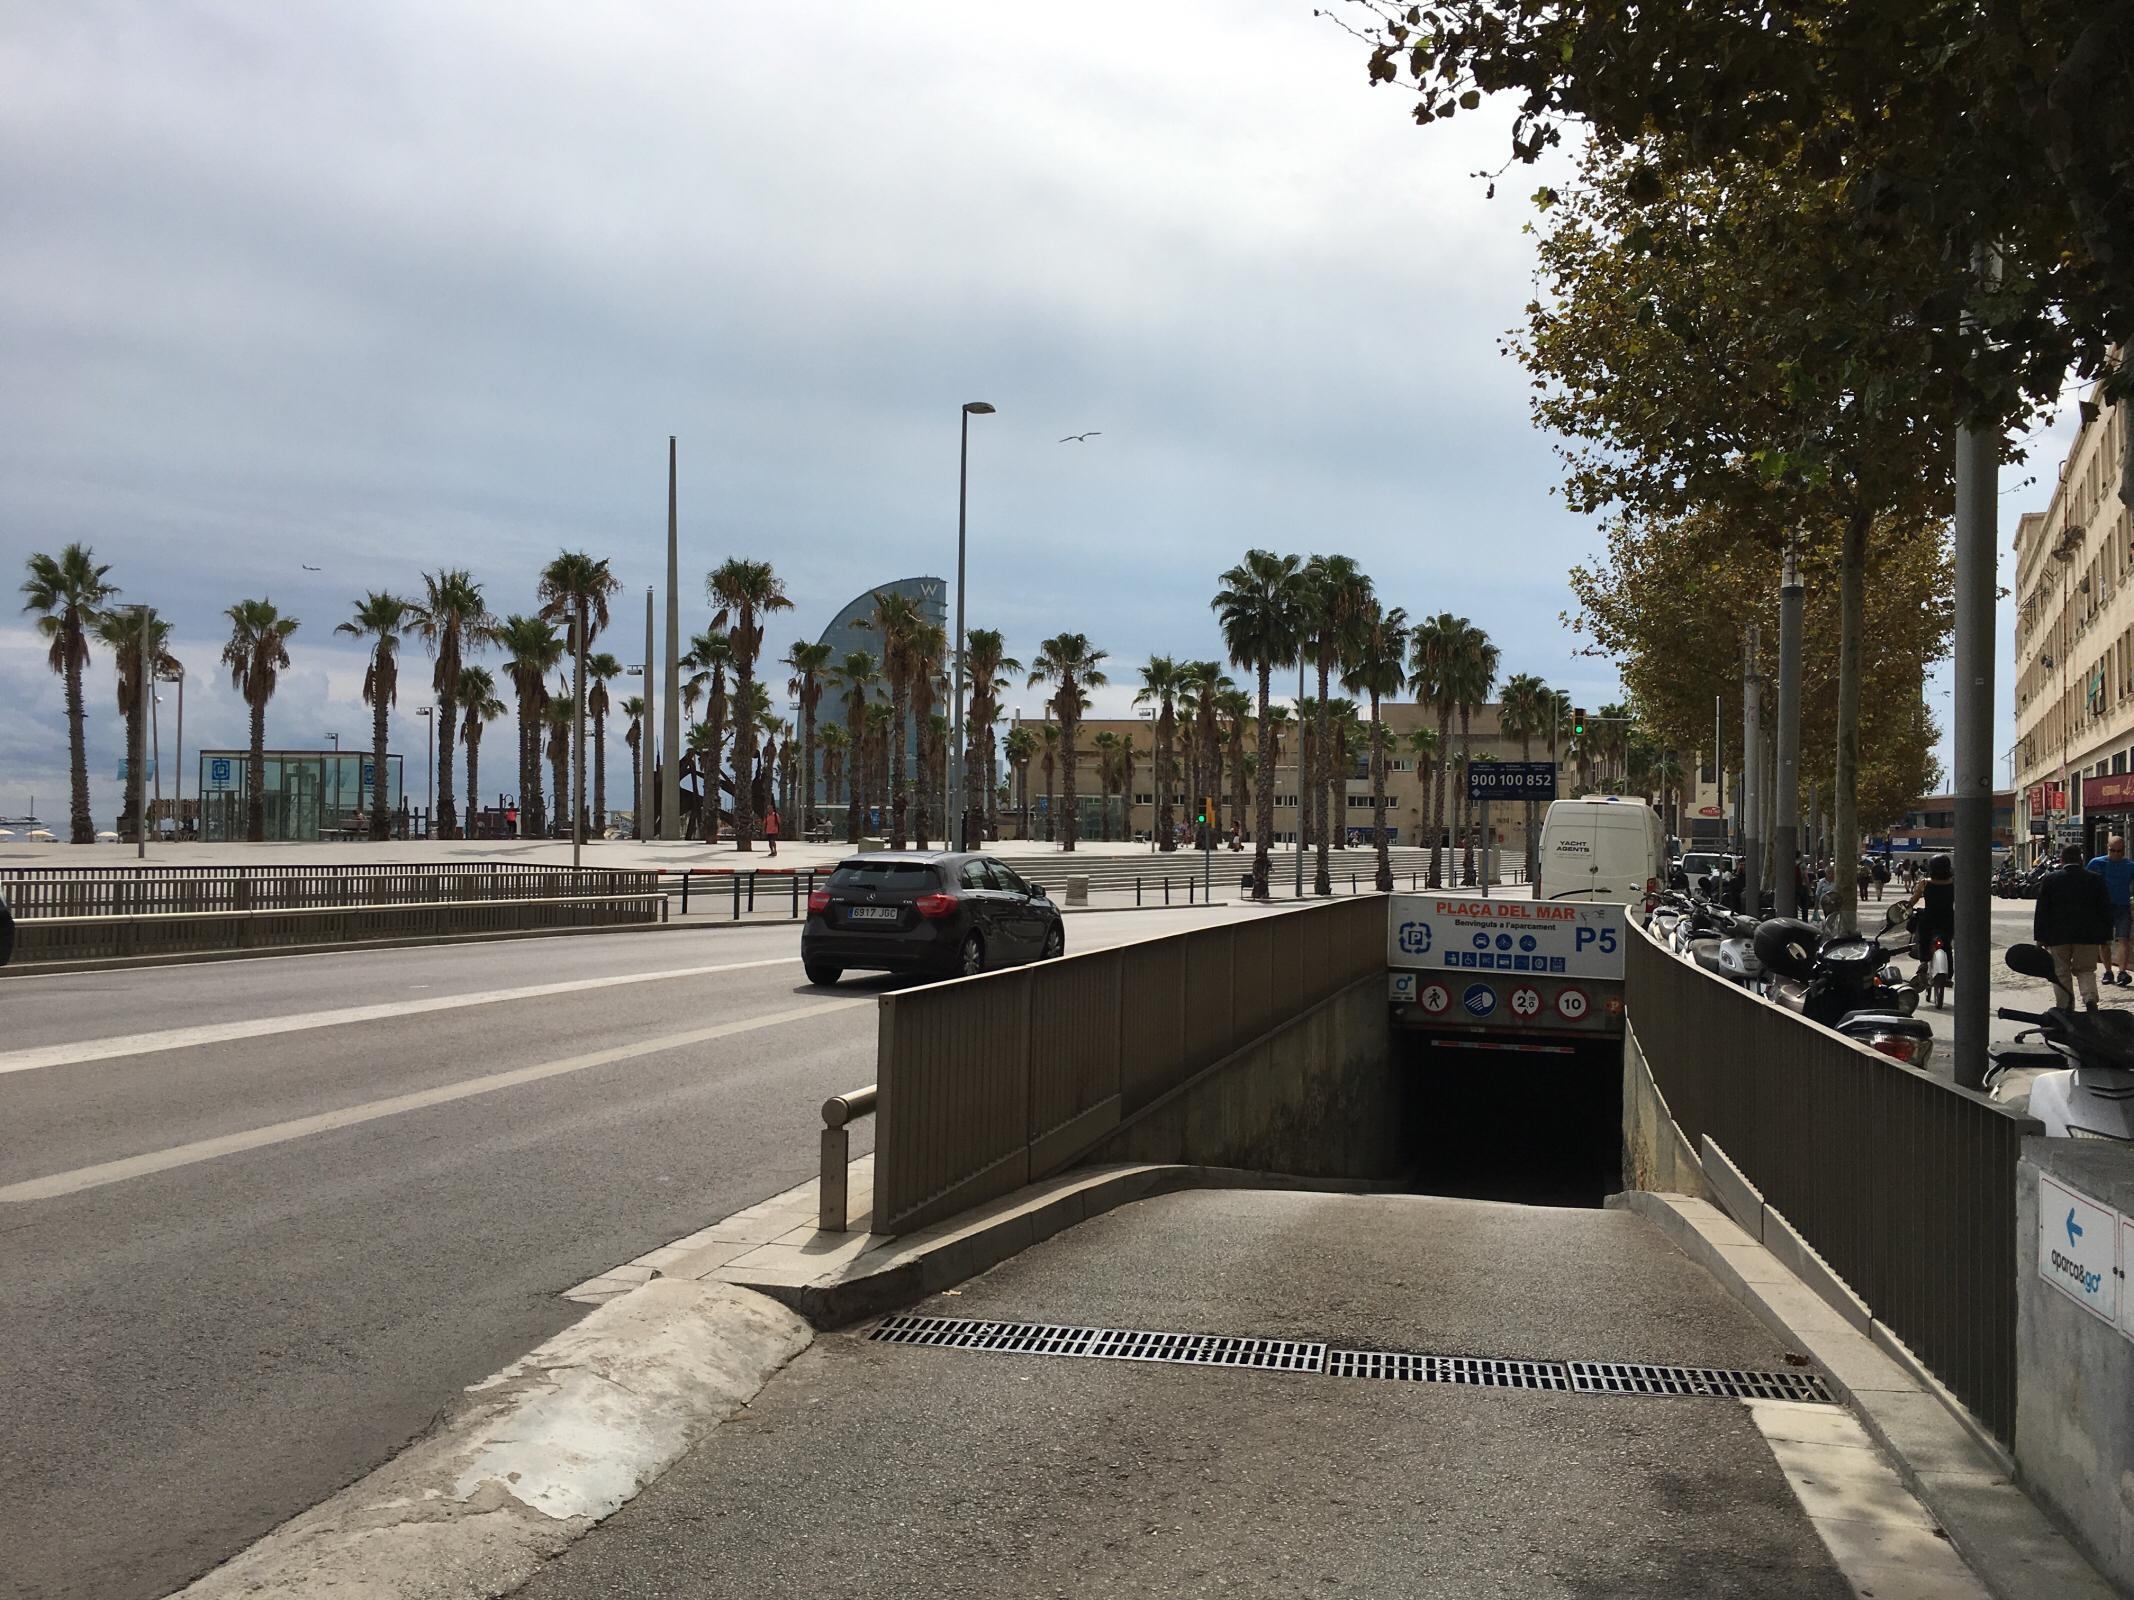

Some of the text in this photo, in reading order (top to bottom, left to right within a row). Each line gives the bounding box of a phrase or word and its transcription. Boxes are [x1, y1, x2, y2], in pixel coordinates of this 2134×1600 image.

[920, 583, 938, 597] W
[1471, 774, 1552, 786] 900 100 852
[854, 908, 896, 918] 6917 JGC
[1436, 902, 1492, 917] PLAÇA
[1497, 904, 1531, 917] DEL
[1536, 906, 1576, 919] MAR
[1454, 918, 1498, 929] Benvinguts
[1505, 922, 1556, 931] l'aparcament
[1575, 926, 1617, 954] P5
[1564, 998, 1582, 1010] 10
